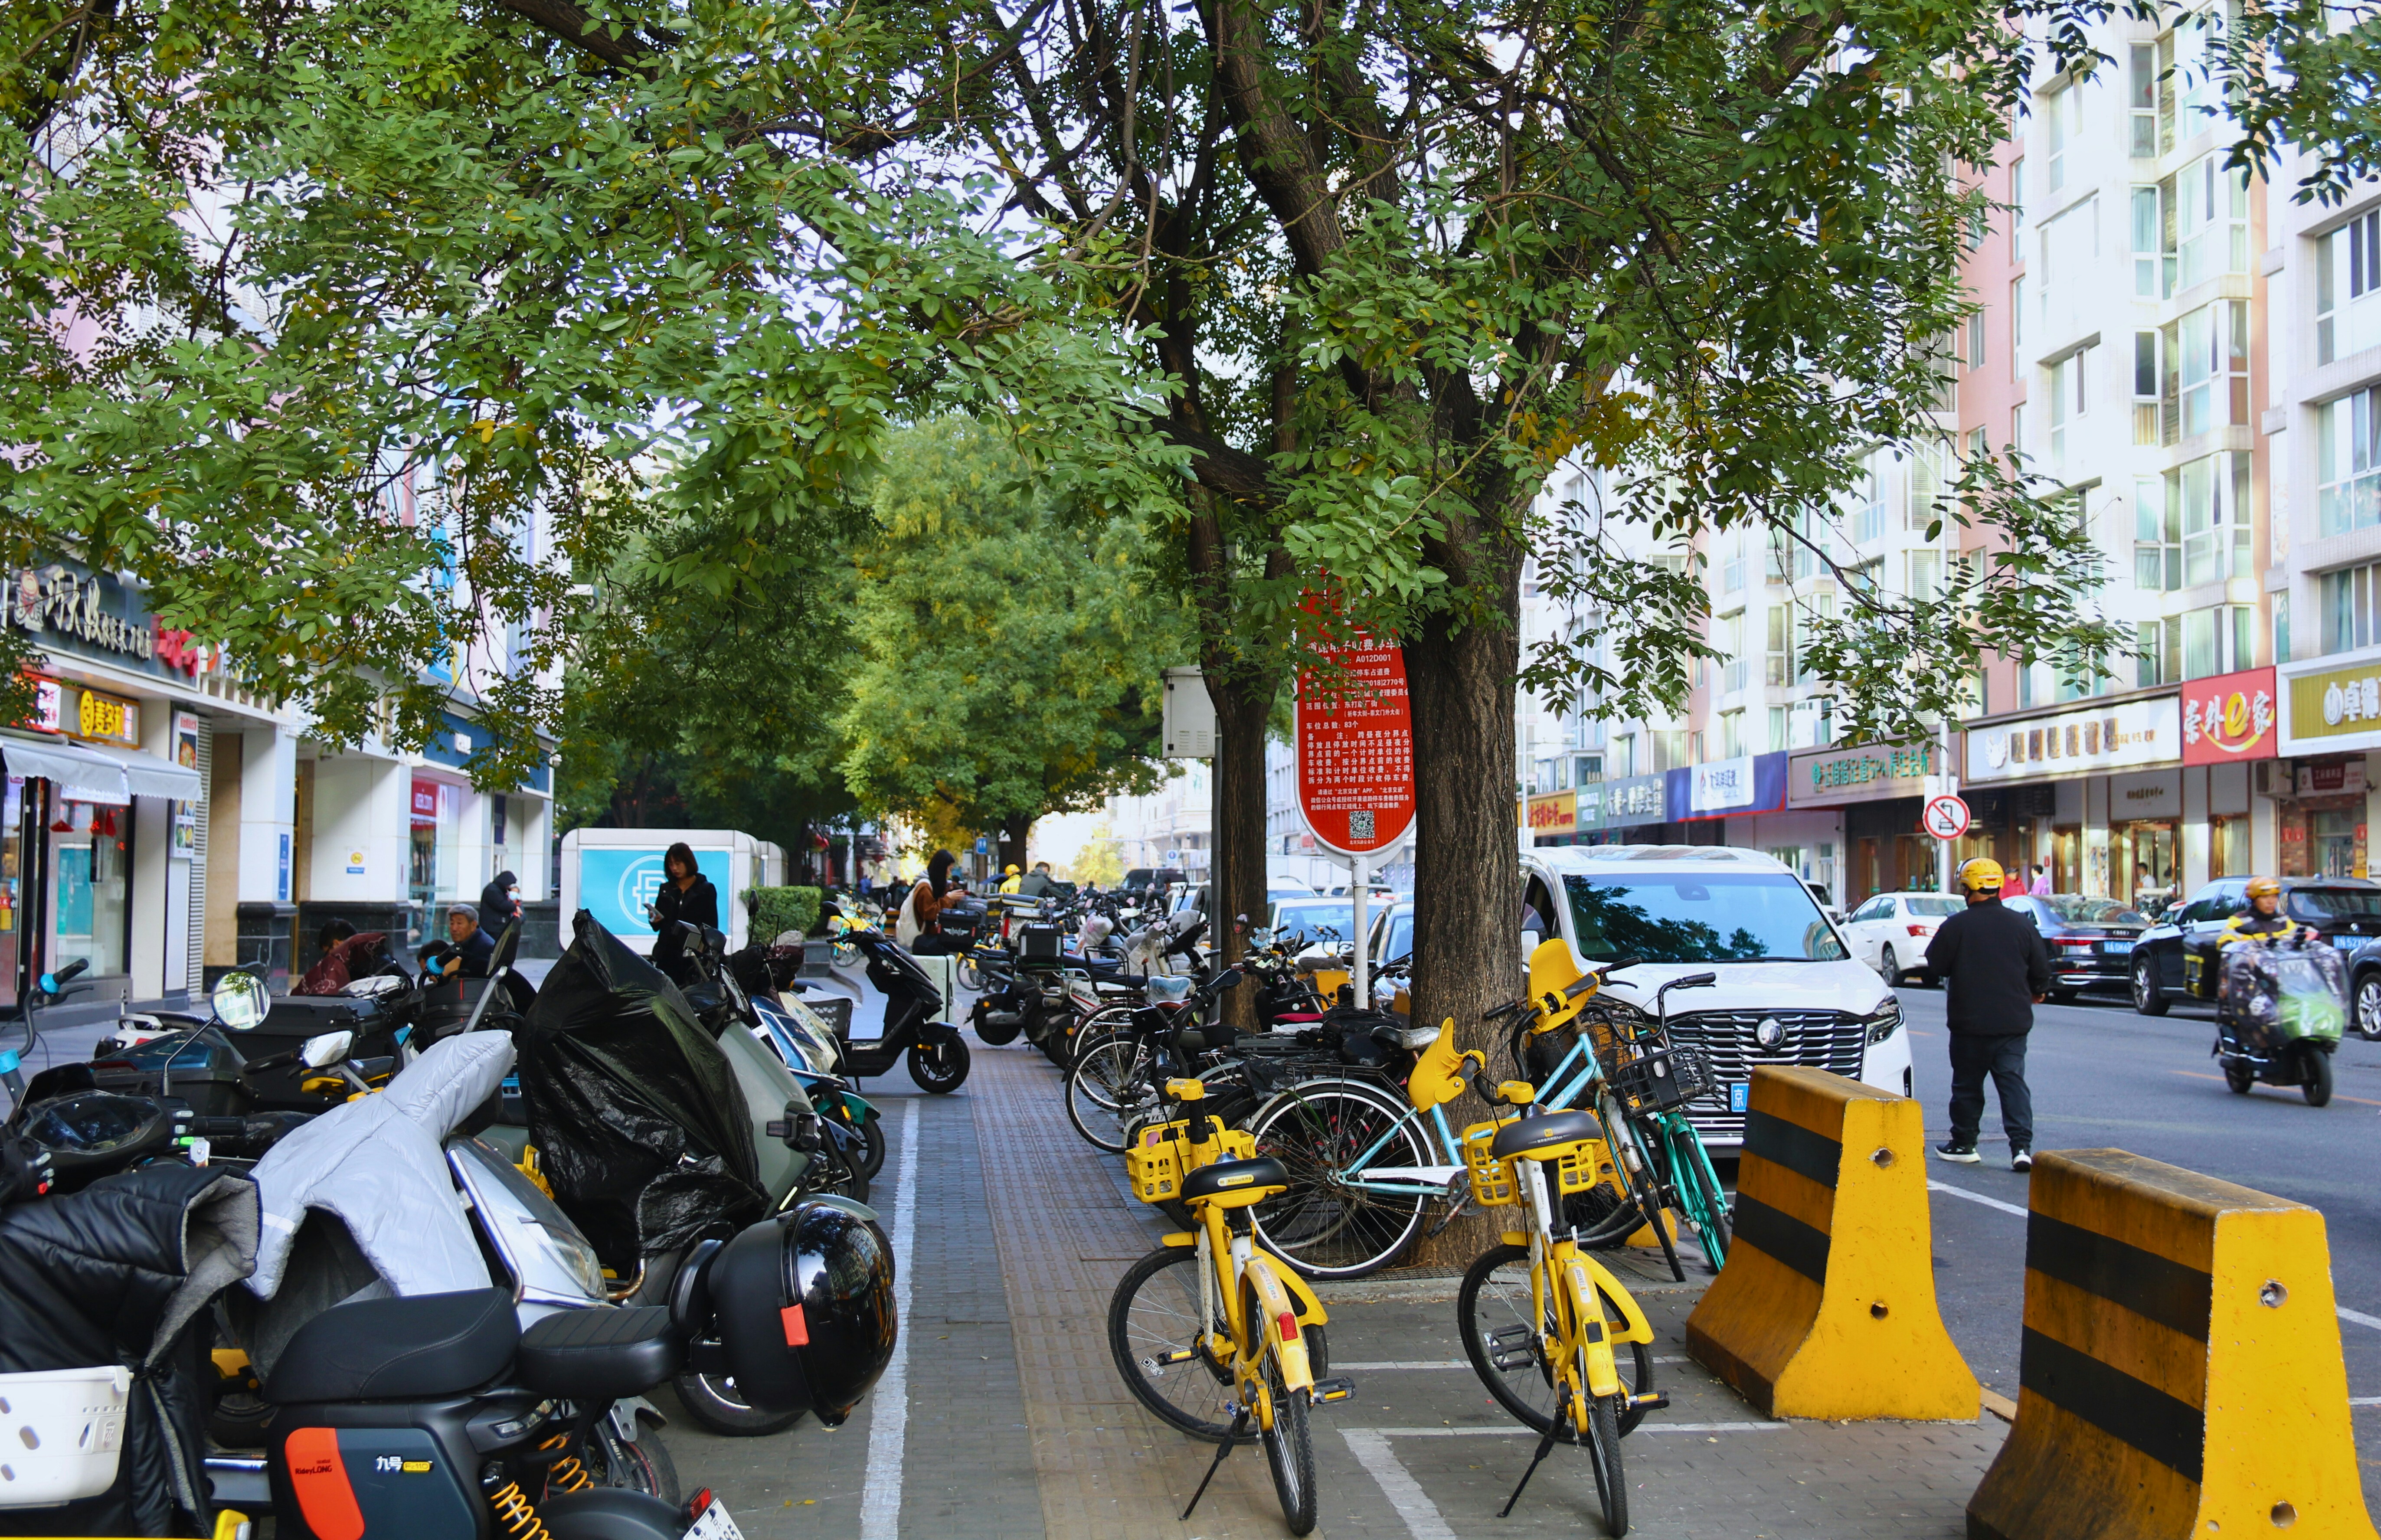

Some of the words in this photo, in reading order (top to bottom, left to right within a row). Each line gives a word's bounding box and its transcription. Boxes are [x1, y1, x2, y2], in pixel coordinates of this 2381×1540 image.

[1356, 654, 1391, 663] A012D001
[376, 1456, 403, 1471] 九号
[295, 1465, 332, 1475] RideyLONG
